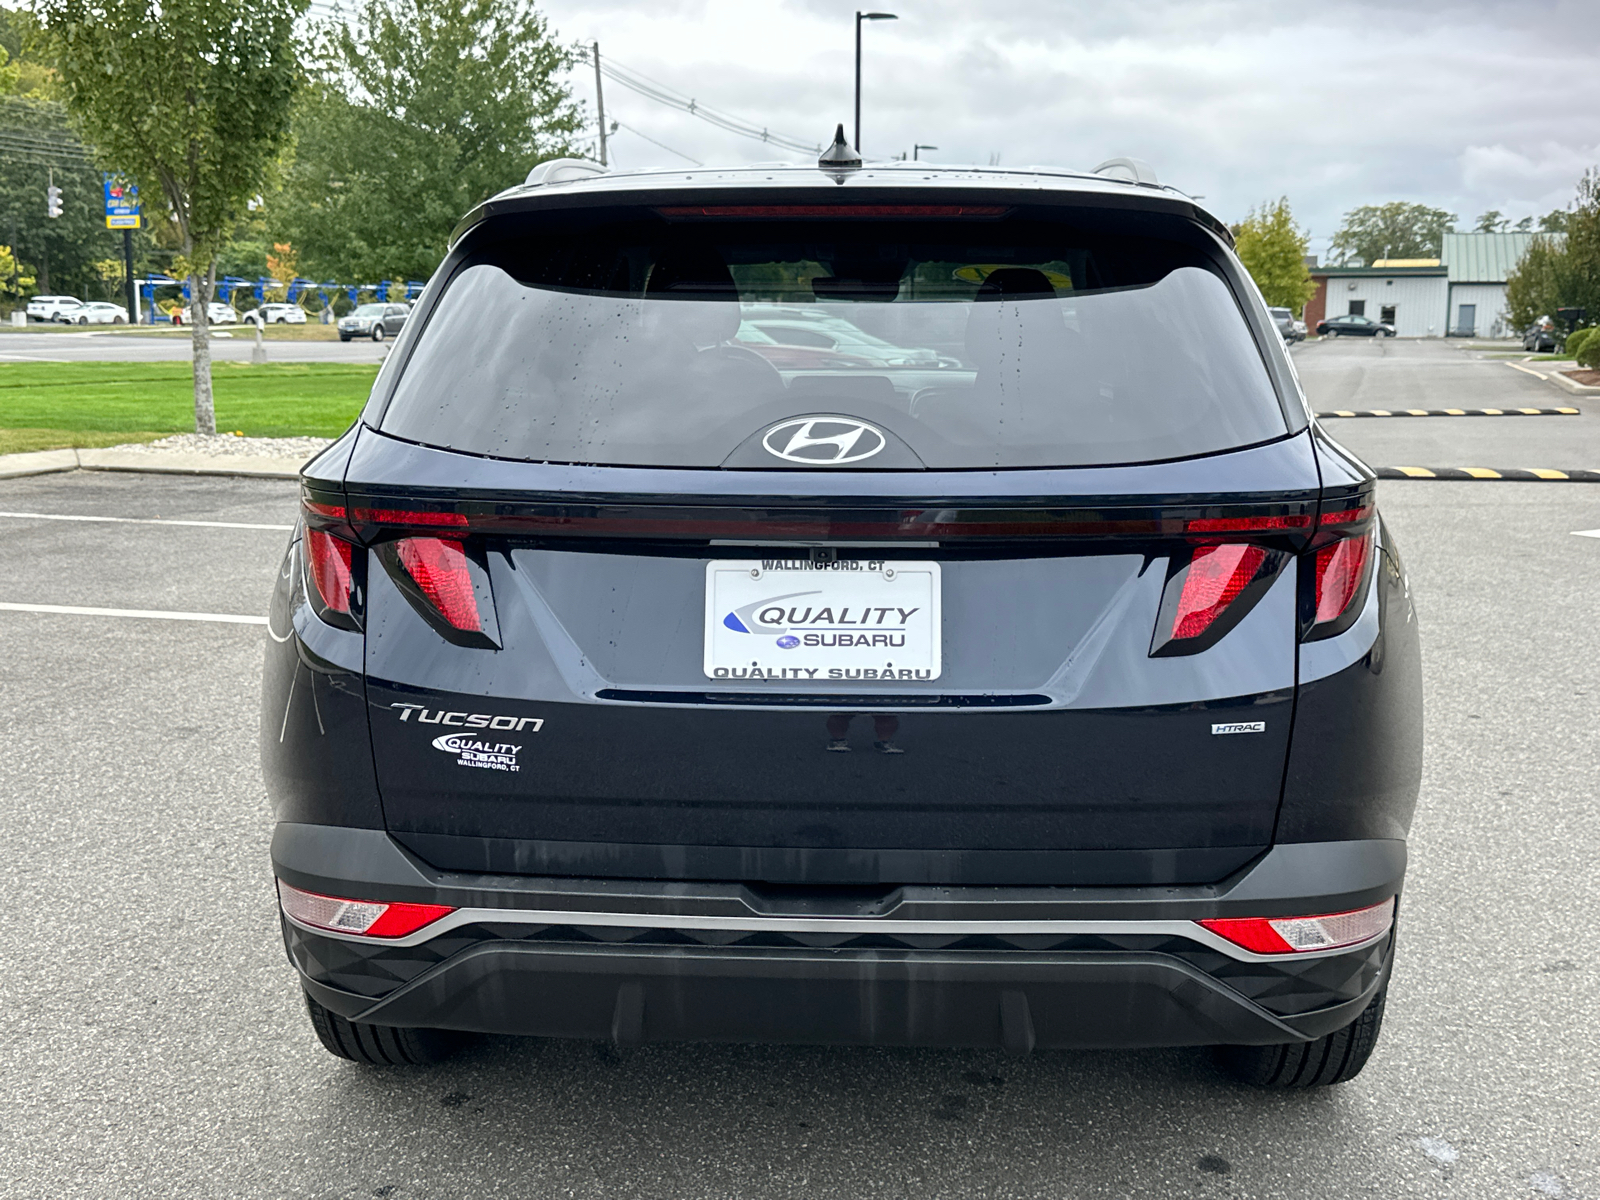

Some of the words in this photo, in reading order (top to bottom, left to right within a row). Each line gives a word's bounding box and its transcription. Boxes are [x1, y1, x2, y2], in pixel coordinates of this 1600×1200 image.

[762, 560, 863, 571] WALLINGFORD,
[868, 561, 885, 571] CT
[758, 607, 920, 625] QUALITY
[803, 634, 906, 647] SUBARU
[713, 668, 819, 679] QUALITY
[828, 669, 931, 680] SUBARU
[1216, 724, 1262, 732] HTRAC
[447, 738, 523, 755] QUALITY
[461, 752, 516, 765] SUBARU
[457, 759, 509, 772] WALLINGFORD,
